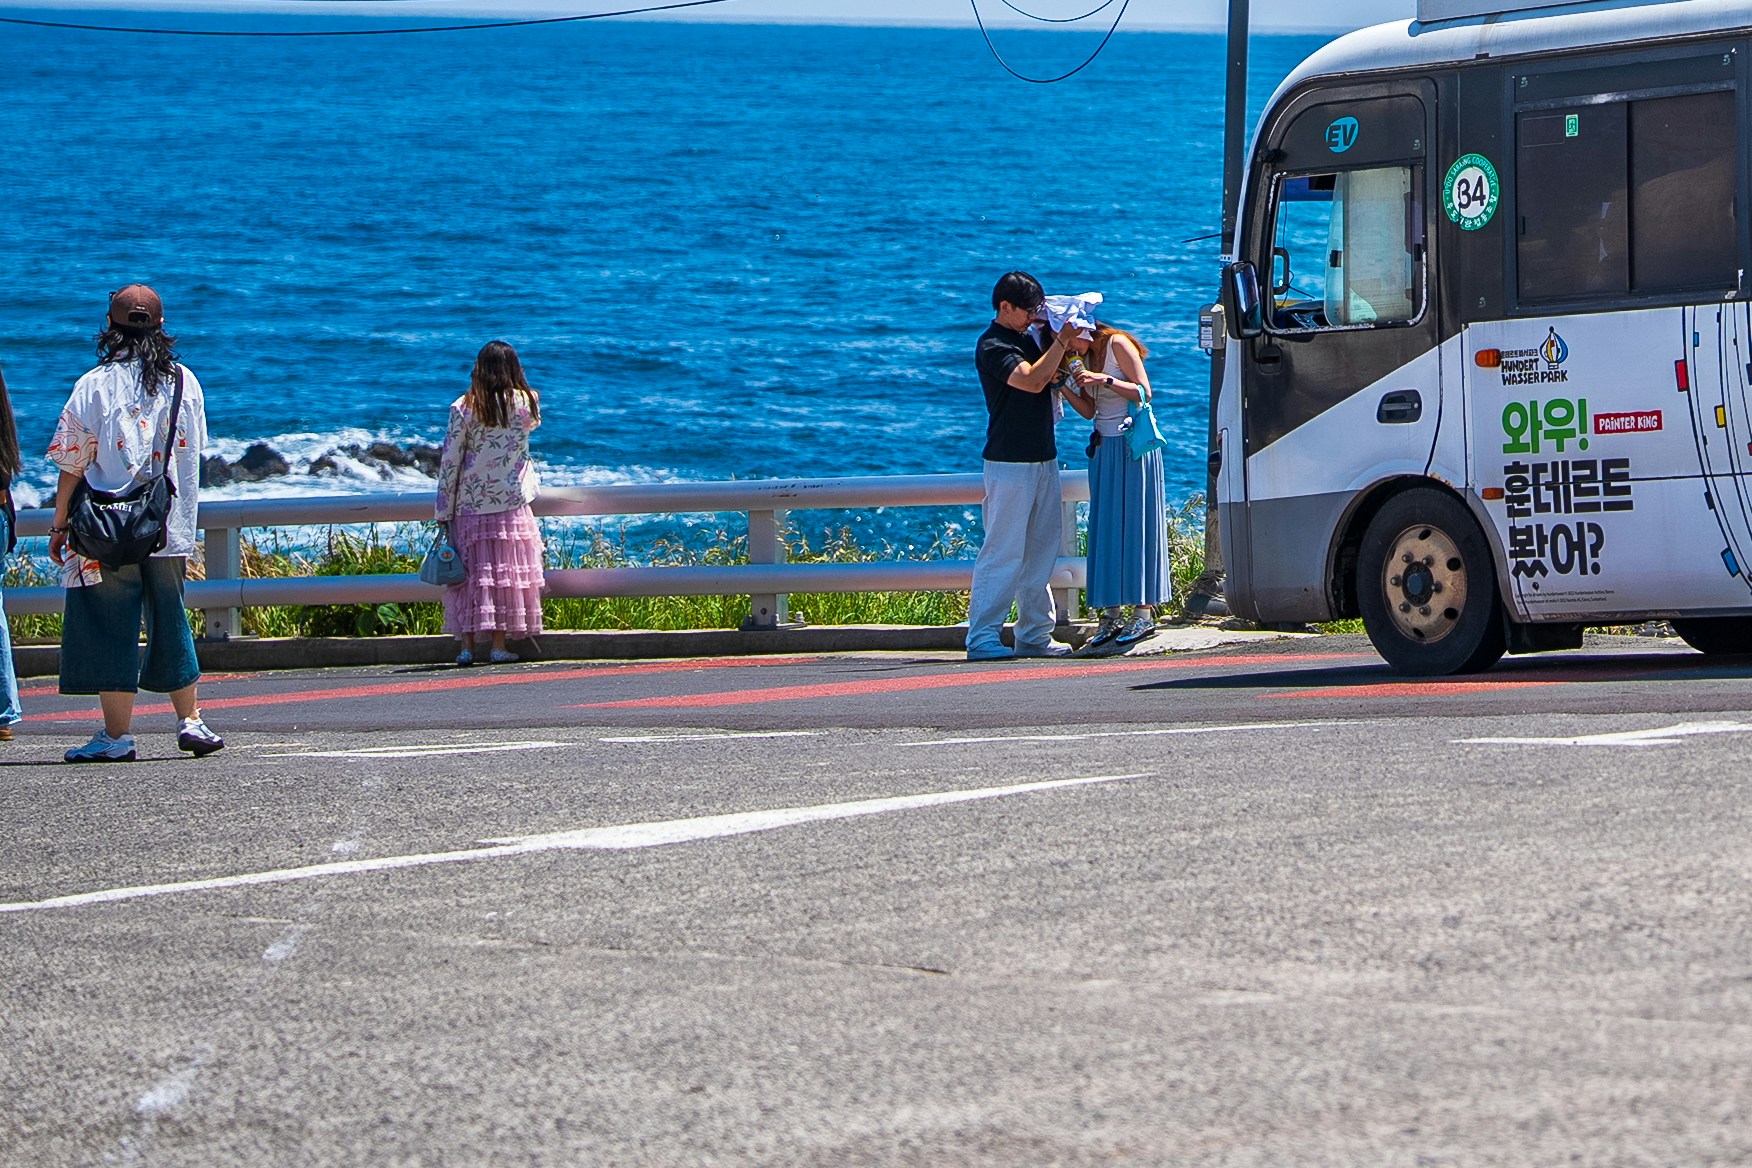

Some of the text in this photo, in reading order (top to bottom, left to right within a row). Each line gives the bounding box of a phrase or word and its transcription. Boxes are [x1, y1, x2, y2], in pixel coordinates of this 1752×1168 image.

[1328, 124, 1356, 147] EV
[1458, 175, 1486, 210] 34
[1501, 358, 1540, 373] HUNDERT
[1502, 398, 1589, 454] 와우!
[1504, 458, 1633, 518] 훈데르트
[1508, 521, 1605, 579] 봤어?
